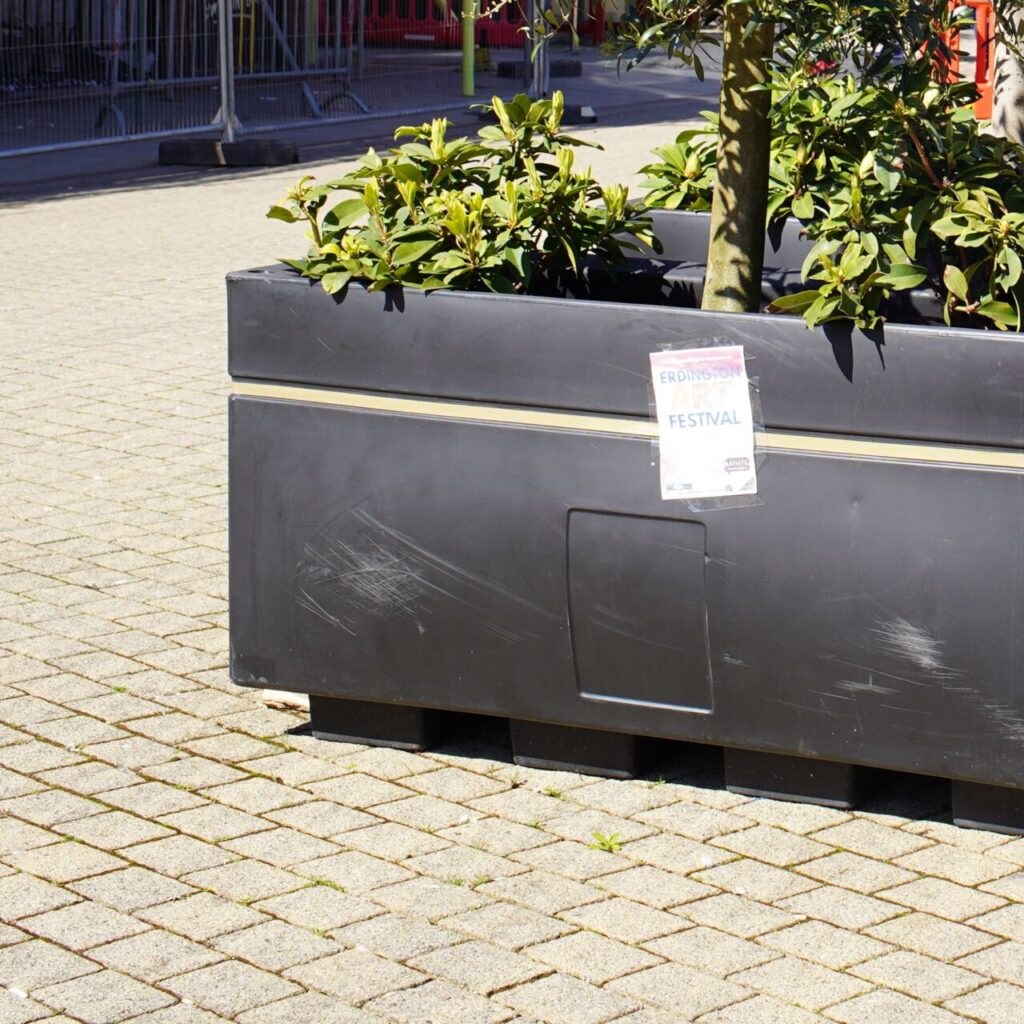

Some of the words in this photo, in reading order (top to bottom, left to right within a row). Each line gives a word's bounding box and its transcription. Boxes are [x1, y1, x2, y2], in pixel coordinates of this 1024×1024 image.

[659, 367, 741, 385] ERDINGTON
[672, 382, 732, 410] ART
[668, 410, 742, 429] FESTIVAL
